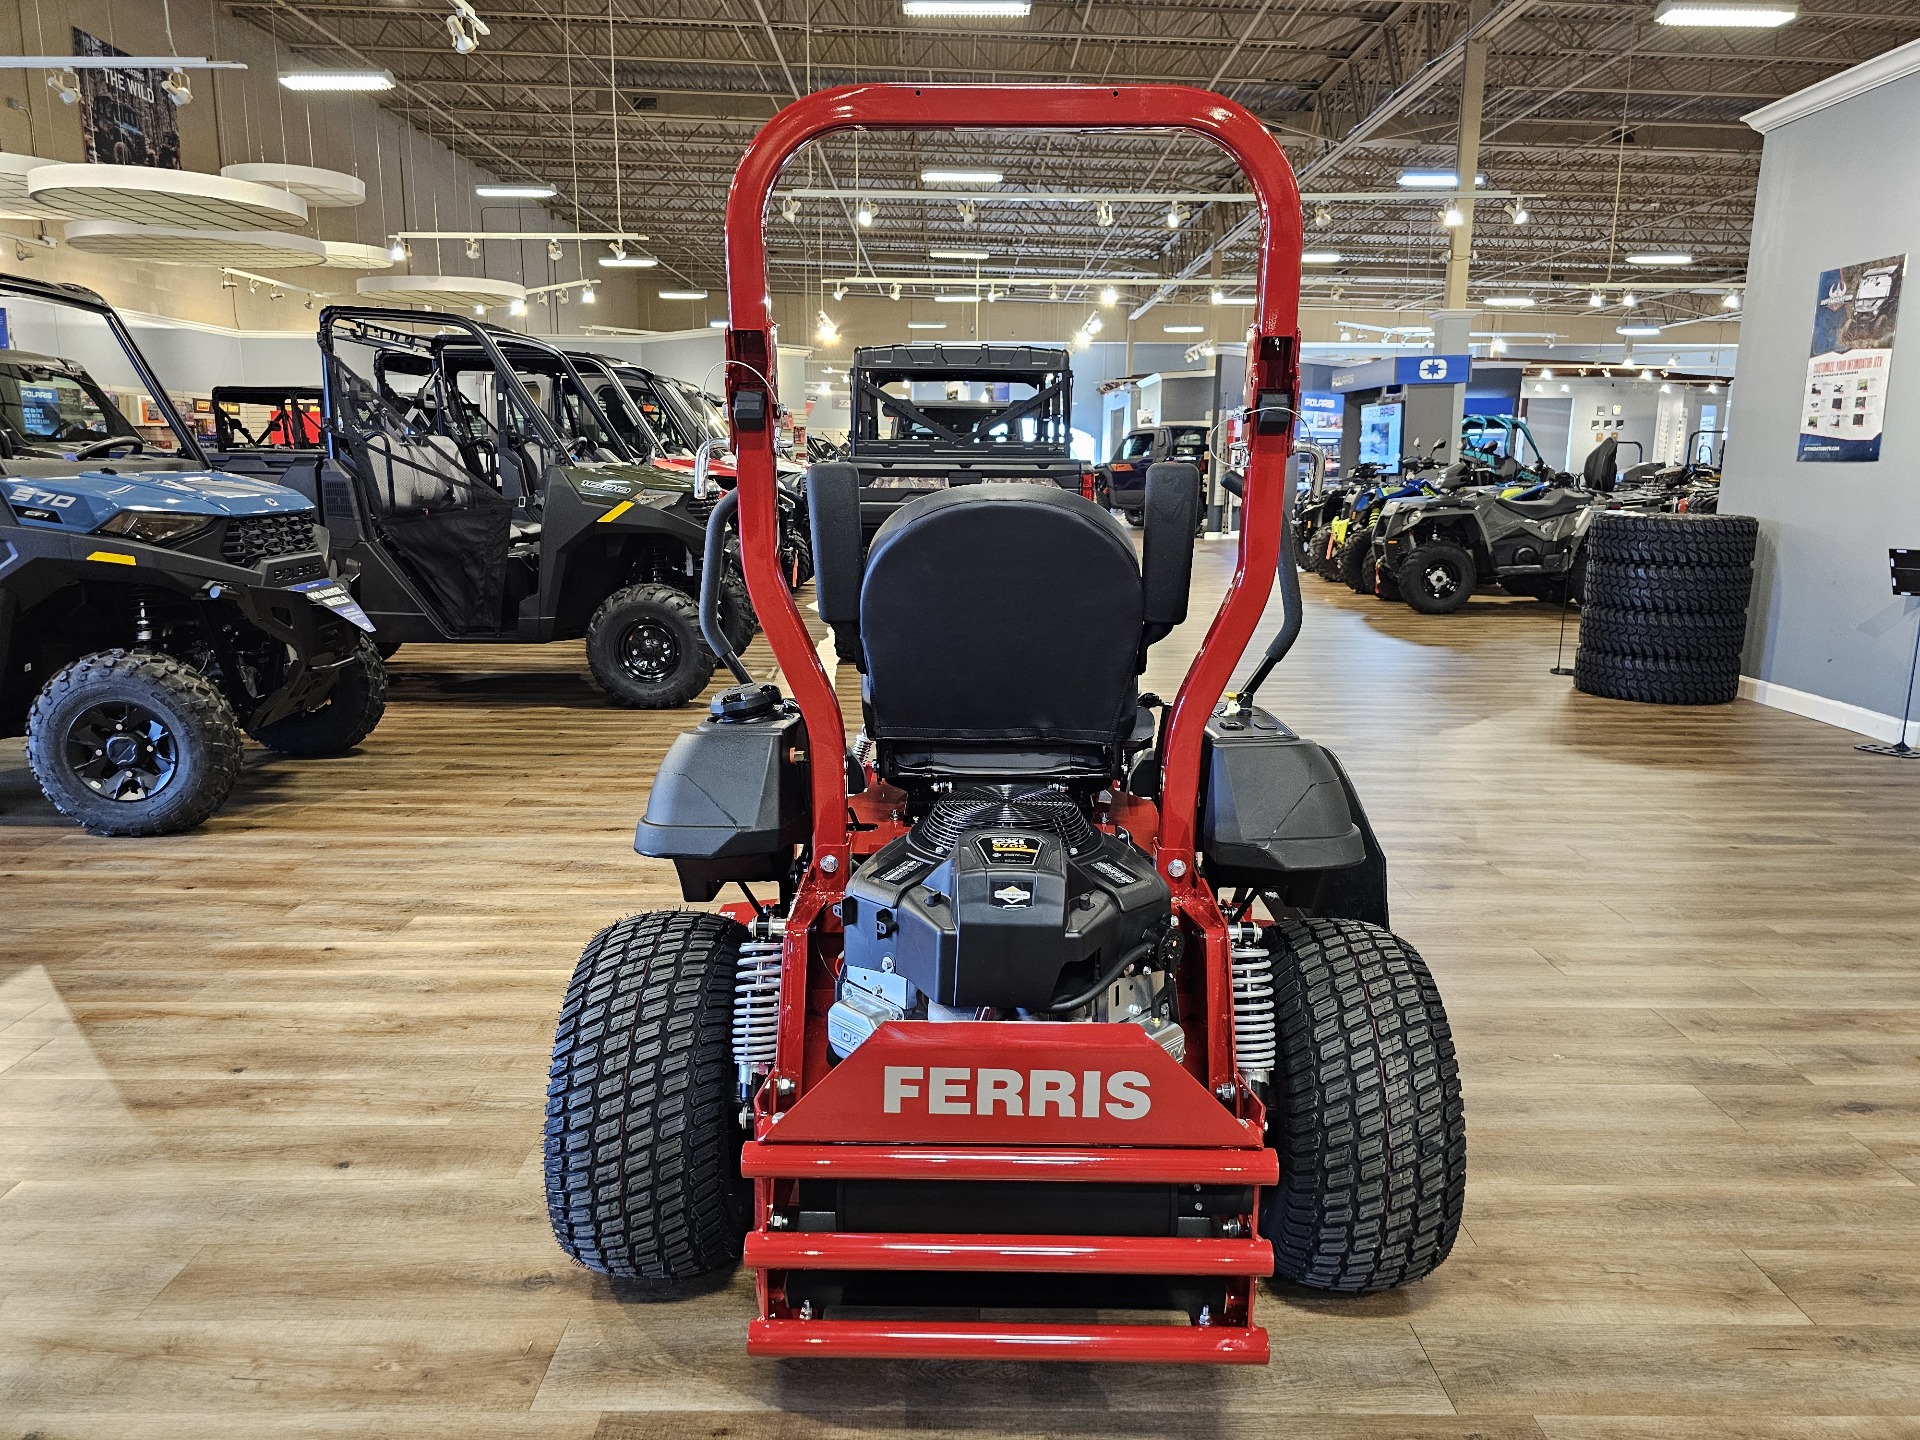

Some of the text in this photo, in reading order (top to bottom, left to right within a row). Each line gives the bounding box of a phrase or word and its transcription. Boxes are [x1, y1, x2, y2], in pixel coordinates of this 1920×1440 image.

[102, 67, 154, 104] THE WILD
[1332, 374, 1355, 388] POLARIS
[21, 390, 53, 399] POLARIS
[1304, 397, 1335, 409] POLARIS
[1368, 406, 1395, 418] POLARIS
[9, 484, 77, 508] 570
[273, 561, 321, 583] POLARIS
[883, 1066, 1152, 1120] FERRIS
